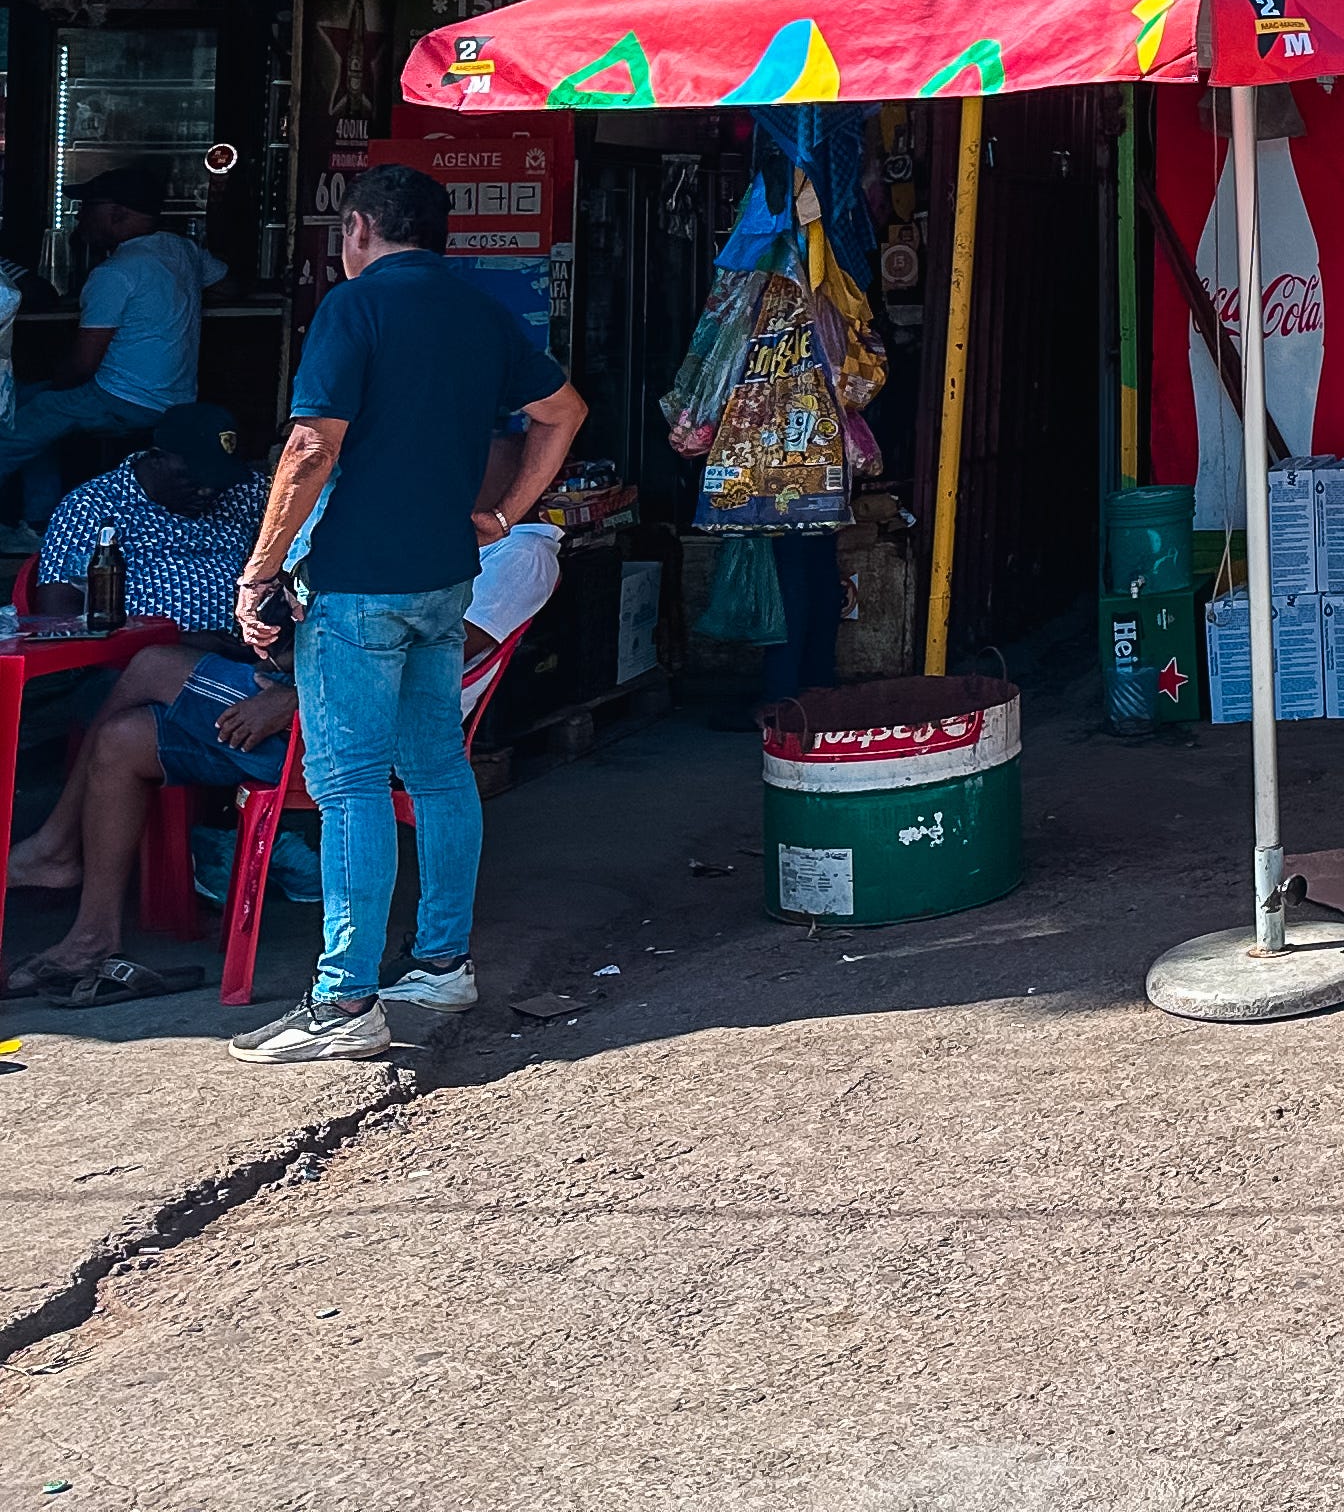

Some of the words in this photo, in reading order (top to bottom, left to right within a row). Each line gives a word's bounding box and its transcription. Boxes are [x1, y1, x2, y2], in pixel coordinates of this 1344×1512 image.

[458, 40, 478, 60] 2
[1282, 32, 1315, 58] M
[463, 74, 492, 94] M
[432, 152, 502, 167] AGENTE
[467, 235, 519, 248] COSSA
[1192, 274, 1323, 340] caCola
